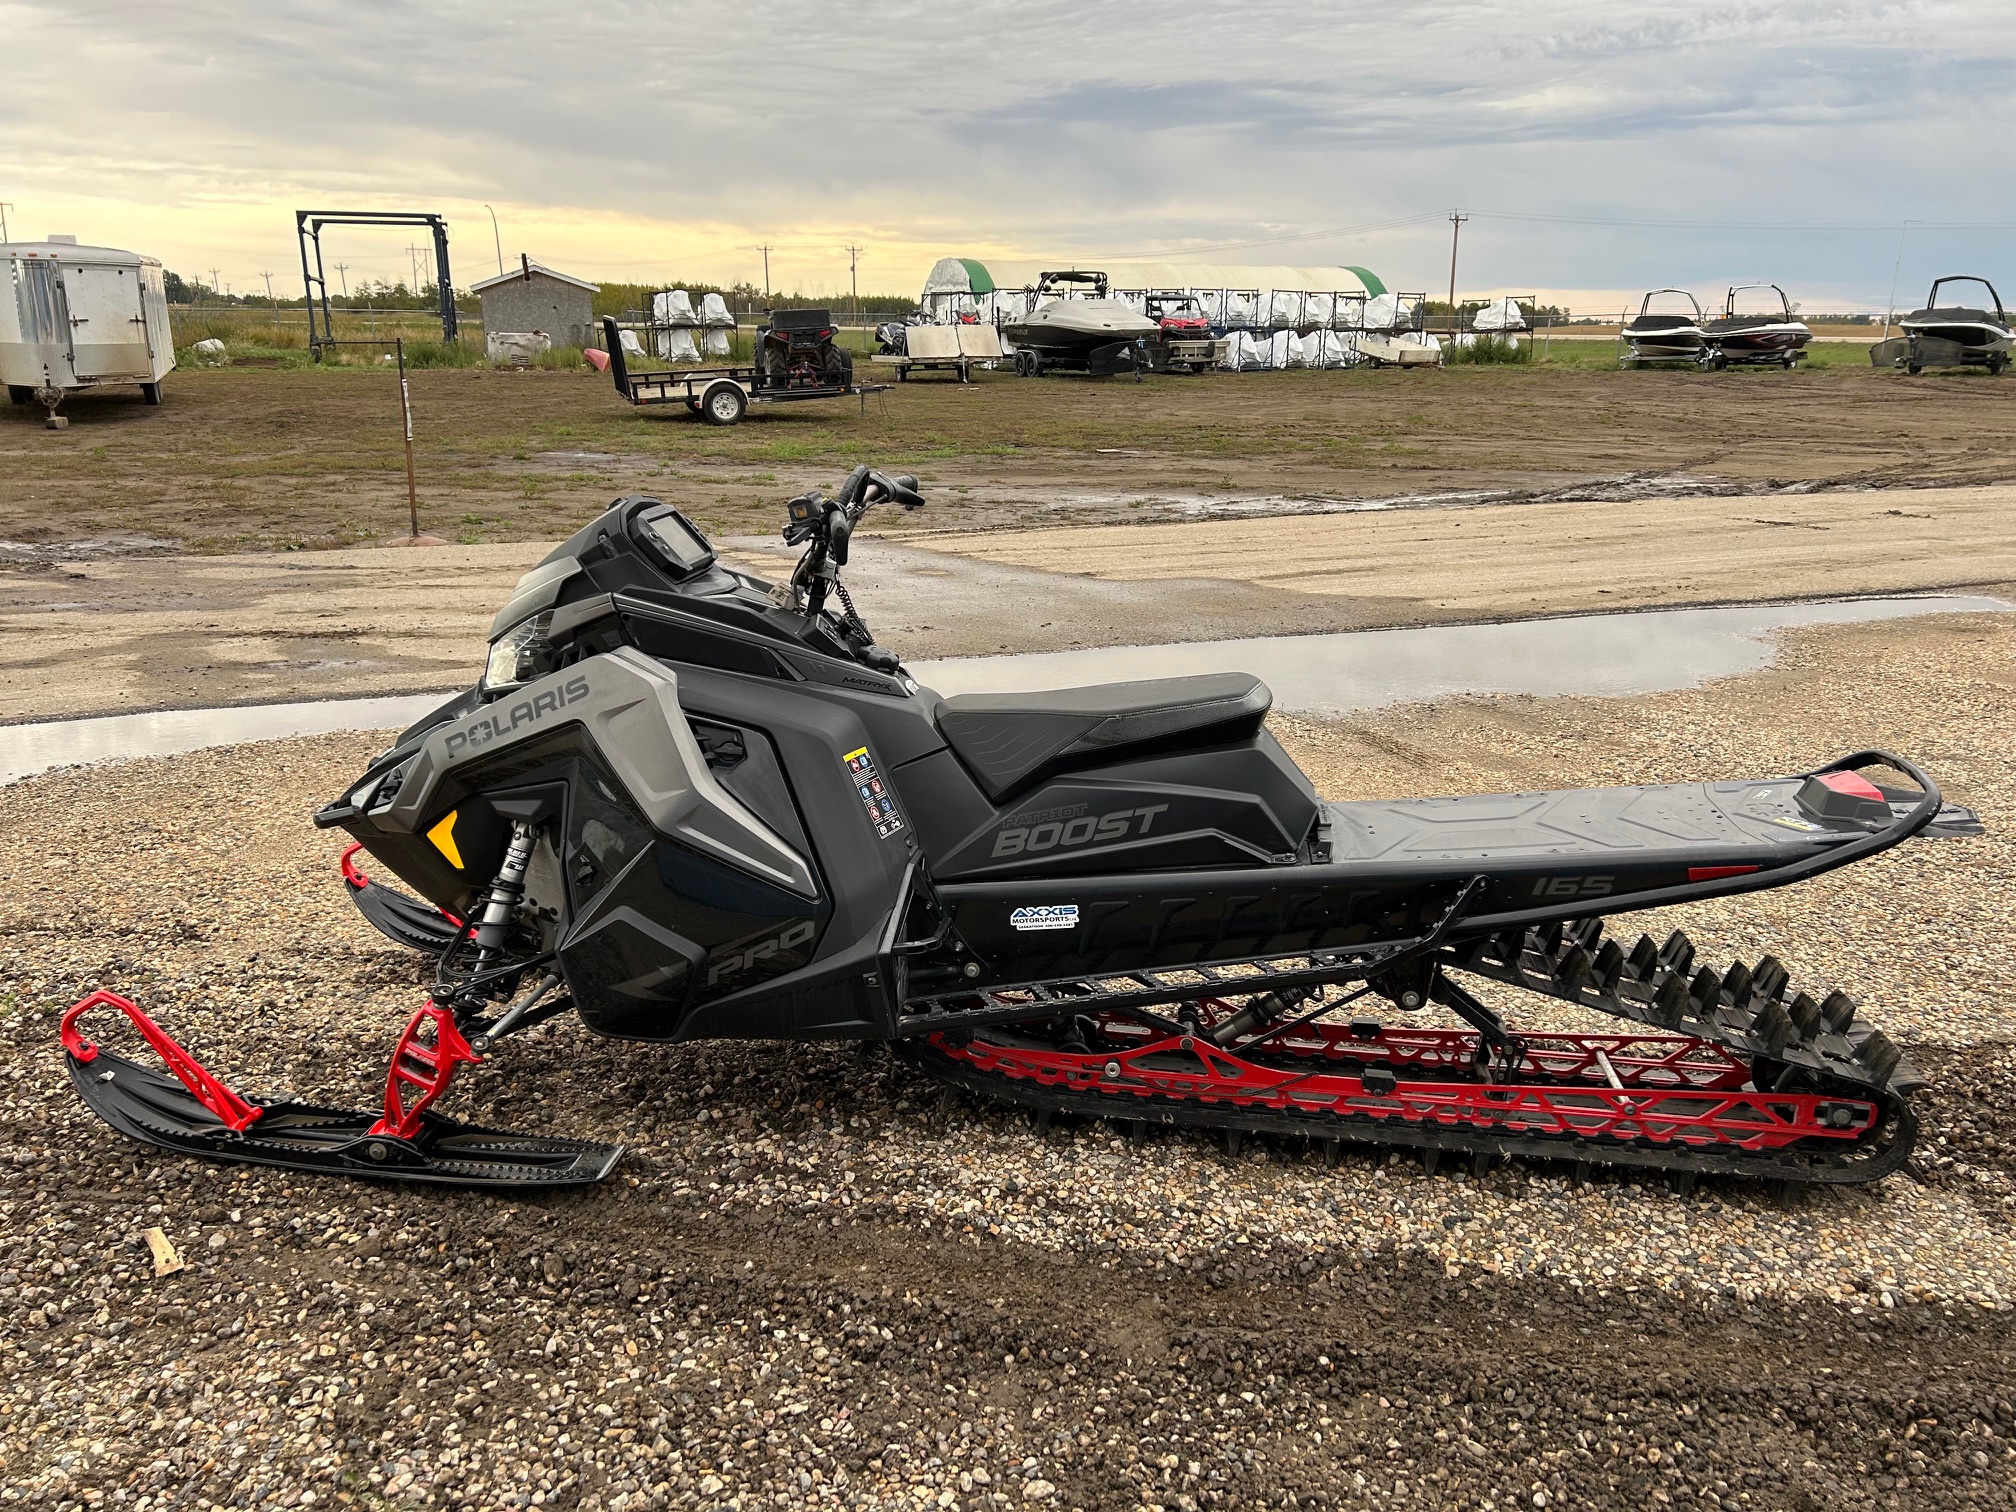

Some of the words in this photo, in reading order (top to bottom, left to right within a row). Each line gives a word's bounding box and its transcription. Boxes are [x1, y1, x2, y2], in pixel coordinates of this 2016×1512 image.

[842, 676, 893, 692] MATRYX
[445, 675, 590, 759] POLARIS
[1002, 802, 1088, 829] PATRIOT
[990, 803, 1170, 858] BOOST
[1531, 875, 1616, 896] 165
[1012, 916, 1069, 924] MOTORSPORTS
[1013, 907, 1077, 918] AXXIS
[707, 921, 815, 987] PRO
